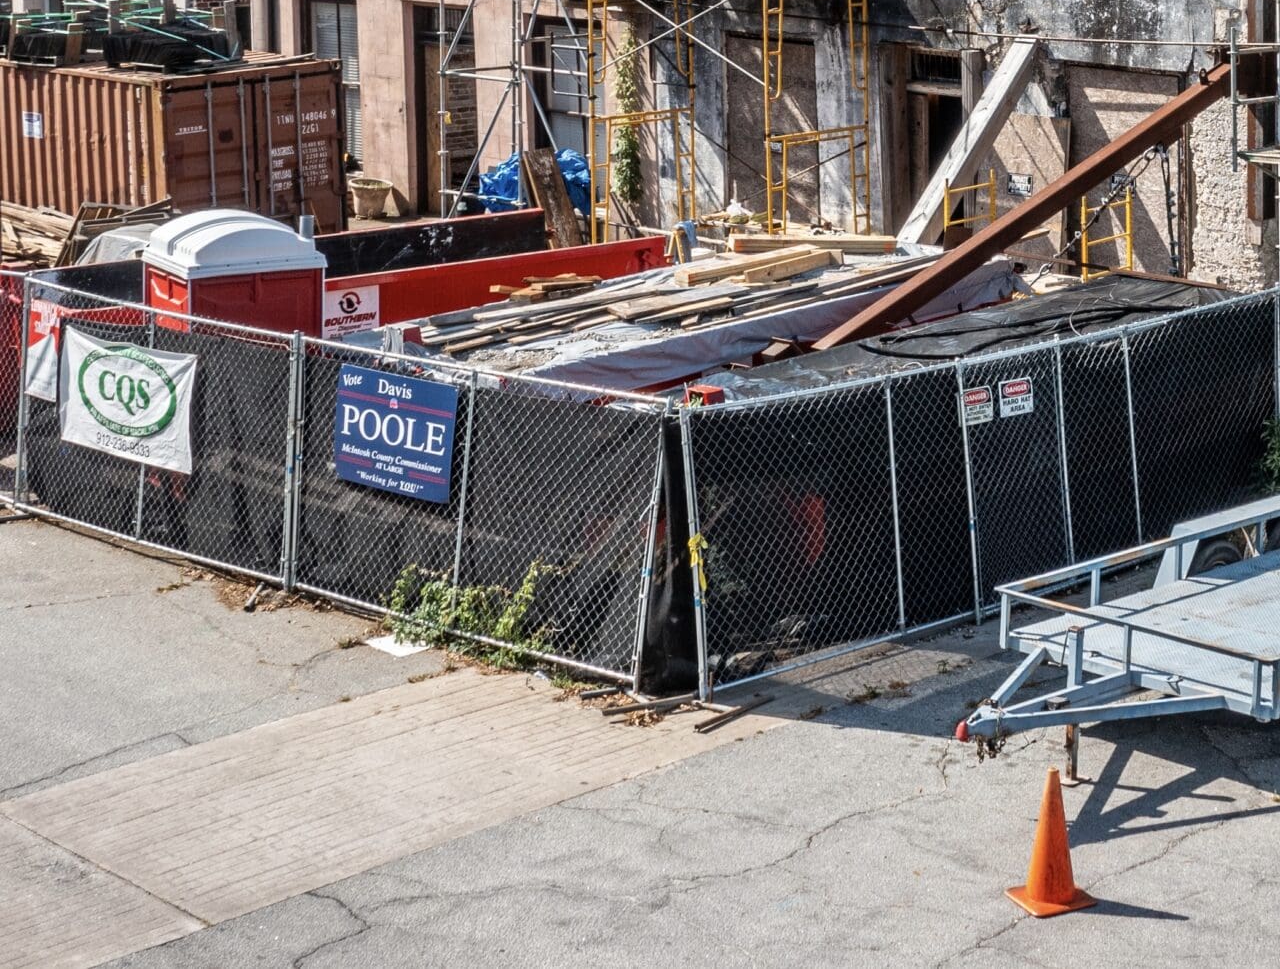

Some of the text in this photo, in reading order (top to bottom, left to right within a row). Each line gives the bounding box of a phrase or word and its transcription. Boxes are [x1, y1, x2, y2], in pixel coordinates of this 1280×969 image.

[324, 311, 377, 327] SOUTHERN
[343, 374, 412, 399] Vote Davis
[1005, 383, 1027, 394] DANGER
[98, 370, 151, 416] CQS
[964, 392, 987, 402] DANGER
[1002, 395, 1031, 407] HARD HAT
[1010, 404, 1026, 412] AREA
[340, 404, 446, 456] POOLE
[341, 443, 443, 474] McIntosh County Commissioner
[383, 463, 403, 475] LARGE
[386, 478, 398, 488] for
